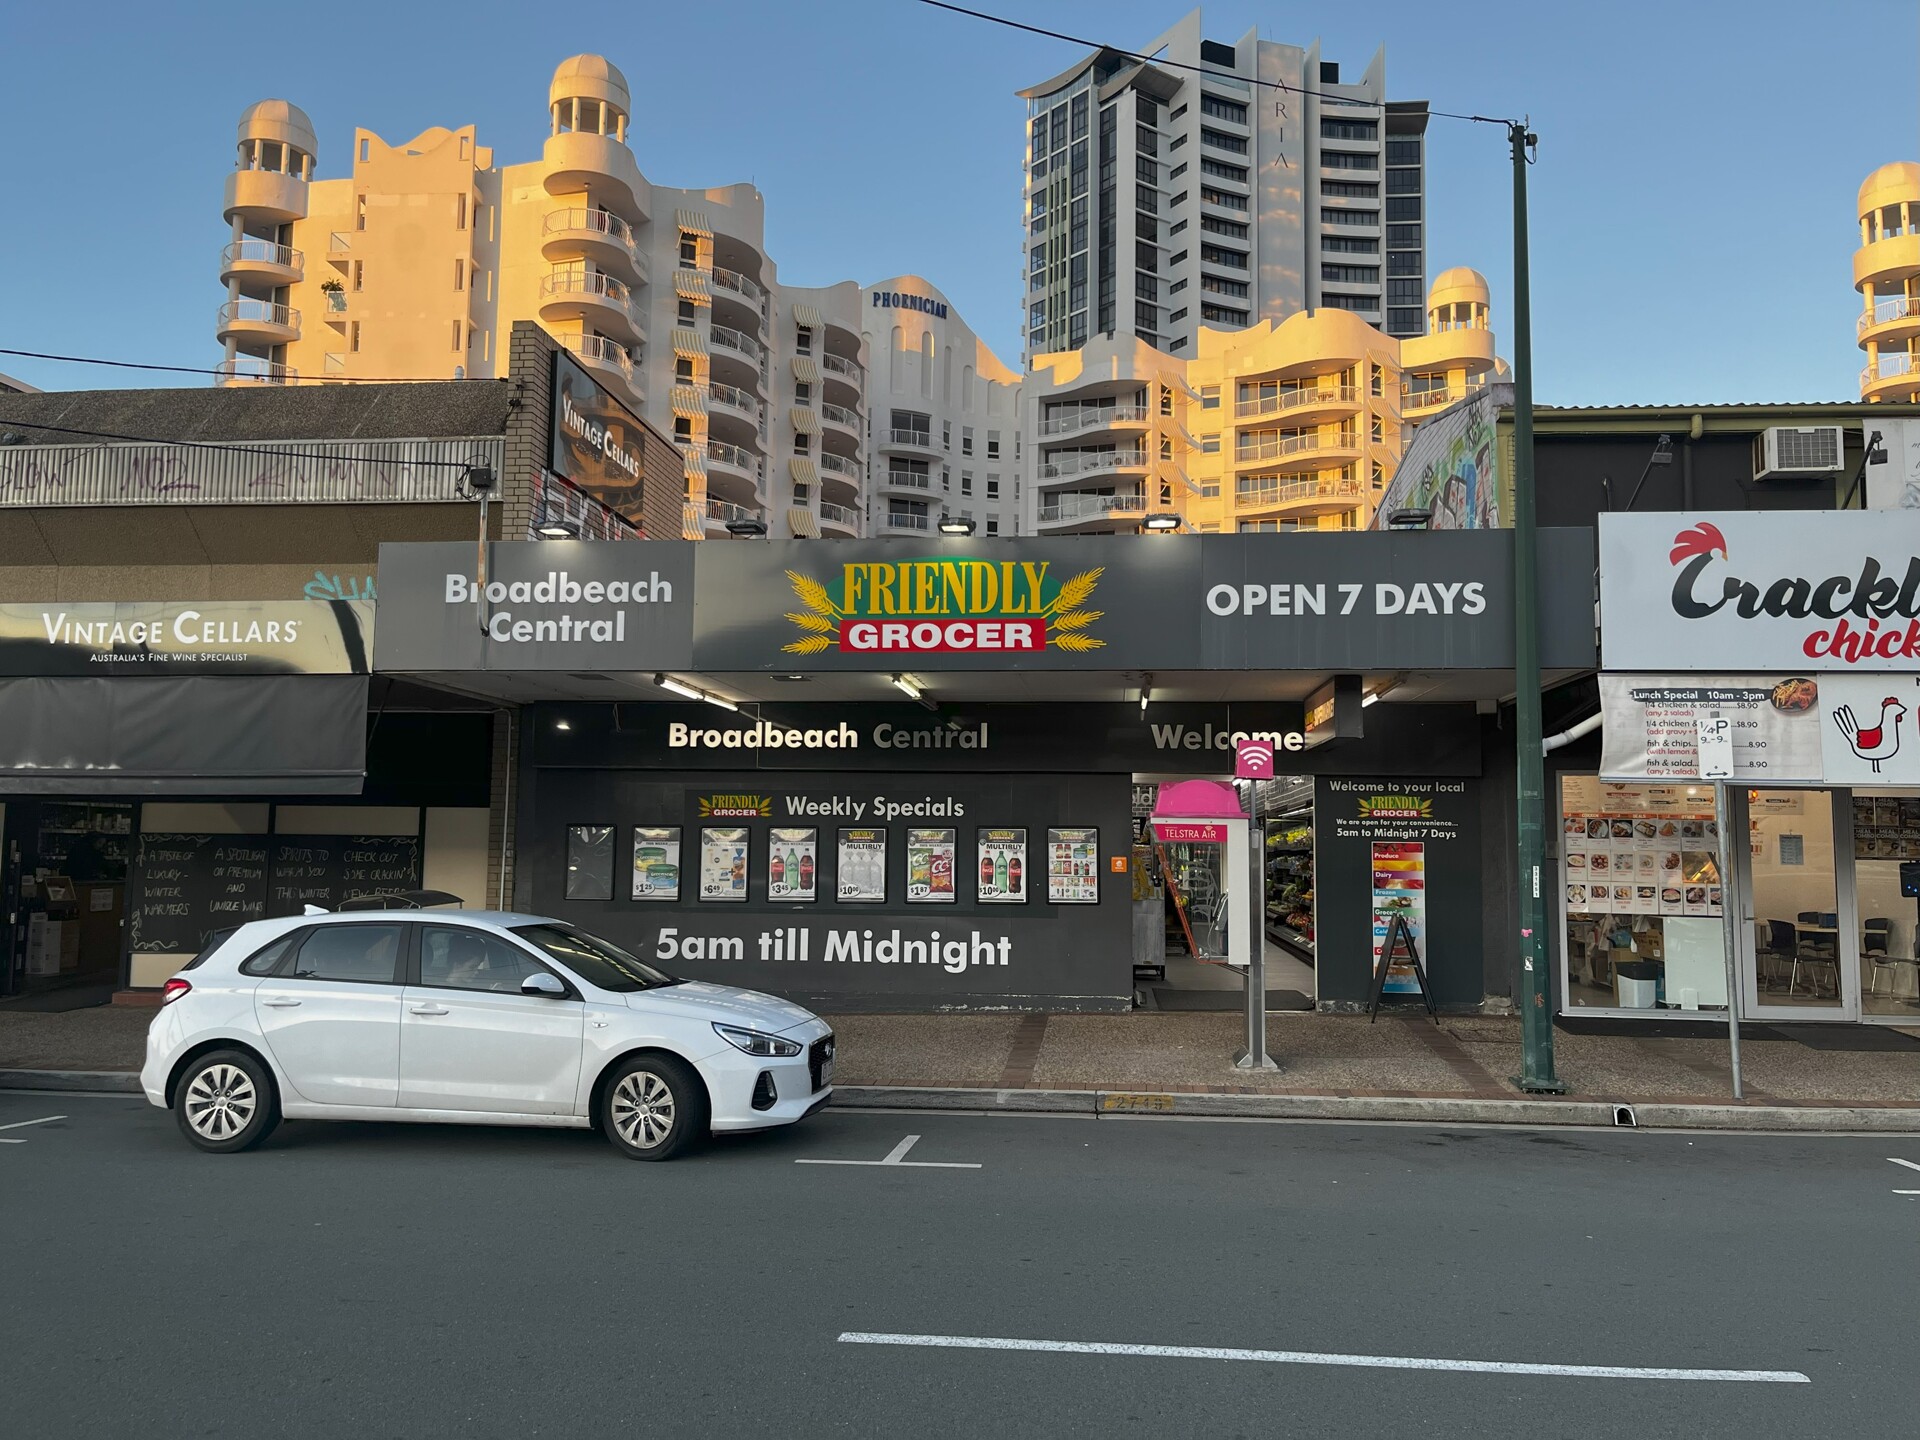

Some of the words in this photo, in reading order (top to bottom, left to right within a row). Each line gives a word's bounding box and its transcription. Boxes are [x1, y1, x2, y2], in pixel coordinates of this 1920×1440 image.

[1274, 78, 1288, 168] ARIA
[873, 291, 948, 319] PHOENICIAN
[562, 393, 602, 450] VINTAGE
[603, 430, 640, 478] CELLARS
[445, 571, 672, 603] Broadbeach
[842, 561, 1050, 615] FRIENDLY
[1206, 583, 1326, 616] OPEN
[1337, 583, 1363, 615] 7
[1375, 581, 1487, 615] DAYS
[43, 612, 162, 644] VINTAGE
[174, 610, 298, 644] CELLARS
[488, 610, 625, 642] Central
[849, 622, 1033, 649] GROCER
[90, 653, 145, 662] AUSTRALIA'S
[149, 653, 169, 662] FINE
[173, 653, 196, 662] WINE
[200, 653, 248, 662] SPECIALIST
[1633, 690, 1661, 699] Lunch
[1663, 690, 1698, 700] Special
[1707, 691, 1734, 699] 10am
[1742, 691, 1765, 701] 3pm
[1657, 701, 1688, 709] chicken
[668, 721, 858, 748] Broadbeach
[873, 722, 988, 749] Central
[1150, 723, 1304, 751] Welcome
[1647, 759, 1659, 767] fish
[1330, 781, 1384, 792] Welcome
[1388, 782, 1400, 792] to
[1404, 783, 1432, 794] your
[1435, 782, 1465, 792] local
[712, 794, 760, 808] FRIENDLY
[1371, 796, 1420, 809] FRIENDLY
[785, 796, 866, 821] Weekly
[873, 796, 965, 822] Specials
[1373, 809, 1418, 817] GROCER
[1165, 829, 1199, 839] TELSTRA
[1336, 828, 1359, 837] 5am
[1361, 829, 1371, 837] to
[1374, 828, 1419, 839] Midnight
[1421, 829, 1428, 837] 7
[1431, 829, 1456, 840] Days
[344, 851, 376, 862] CHECK
[379, 853, 399, 863] OUT
[308, 866, 326, 878] YOU
[144, 886, 182, 897] WINTER
[226, 883, 245, 893] AND
[299, 887, 330, 899] WINTER
[144, 903, 190, 916] WARMERS
[209, 900, 240, 912] UNIQUE
[656, 928, 744, 960] 5am
[758, 927, 809, 961] till
[823, 929, 1012, 974] Midnight
